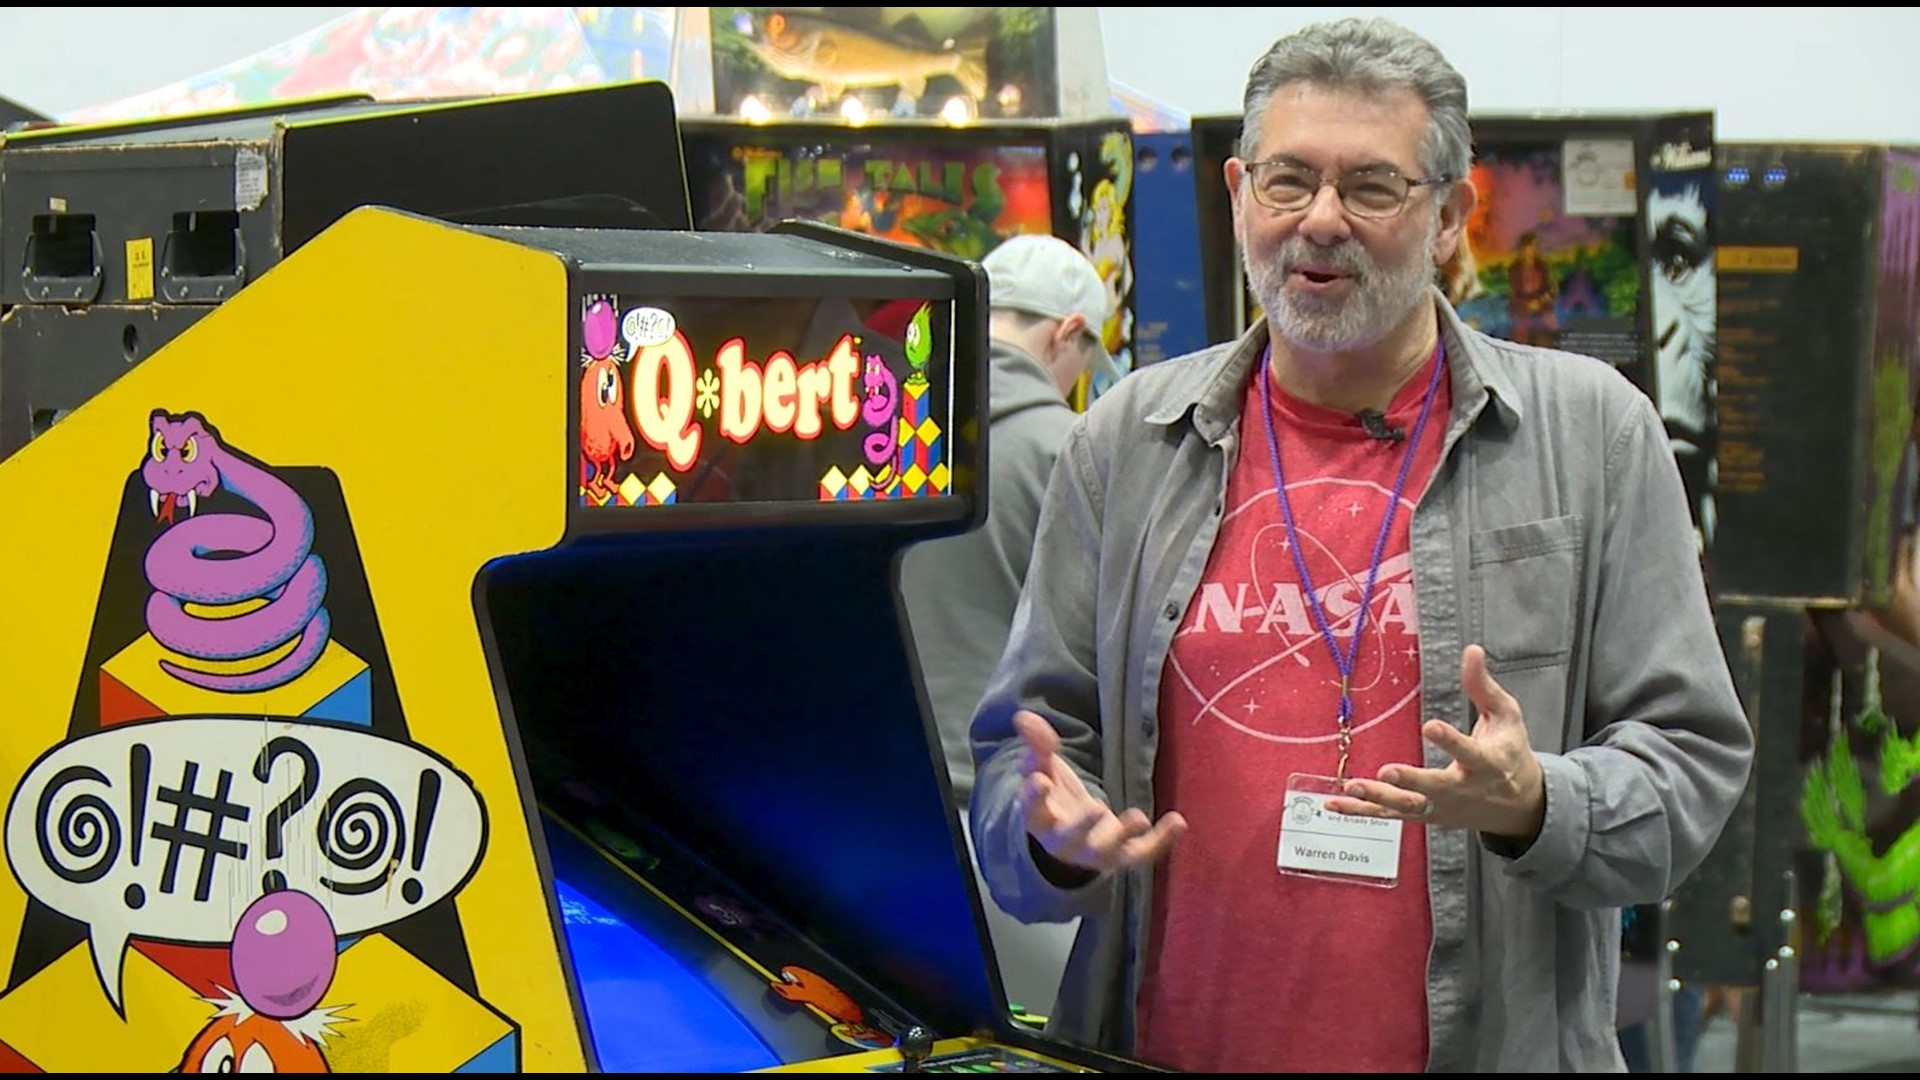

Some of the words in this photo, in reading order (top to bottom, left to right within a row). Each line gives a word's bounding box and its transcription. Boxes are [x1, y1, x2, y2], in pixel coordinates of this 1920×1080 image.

[865, 158, 1005, 226] TALES
[1190, 581, 1418, 638] NASA
[1294, 845, 1336, 861] Warren
[1338, 850, 1370, 864] Davis
